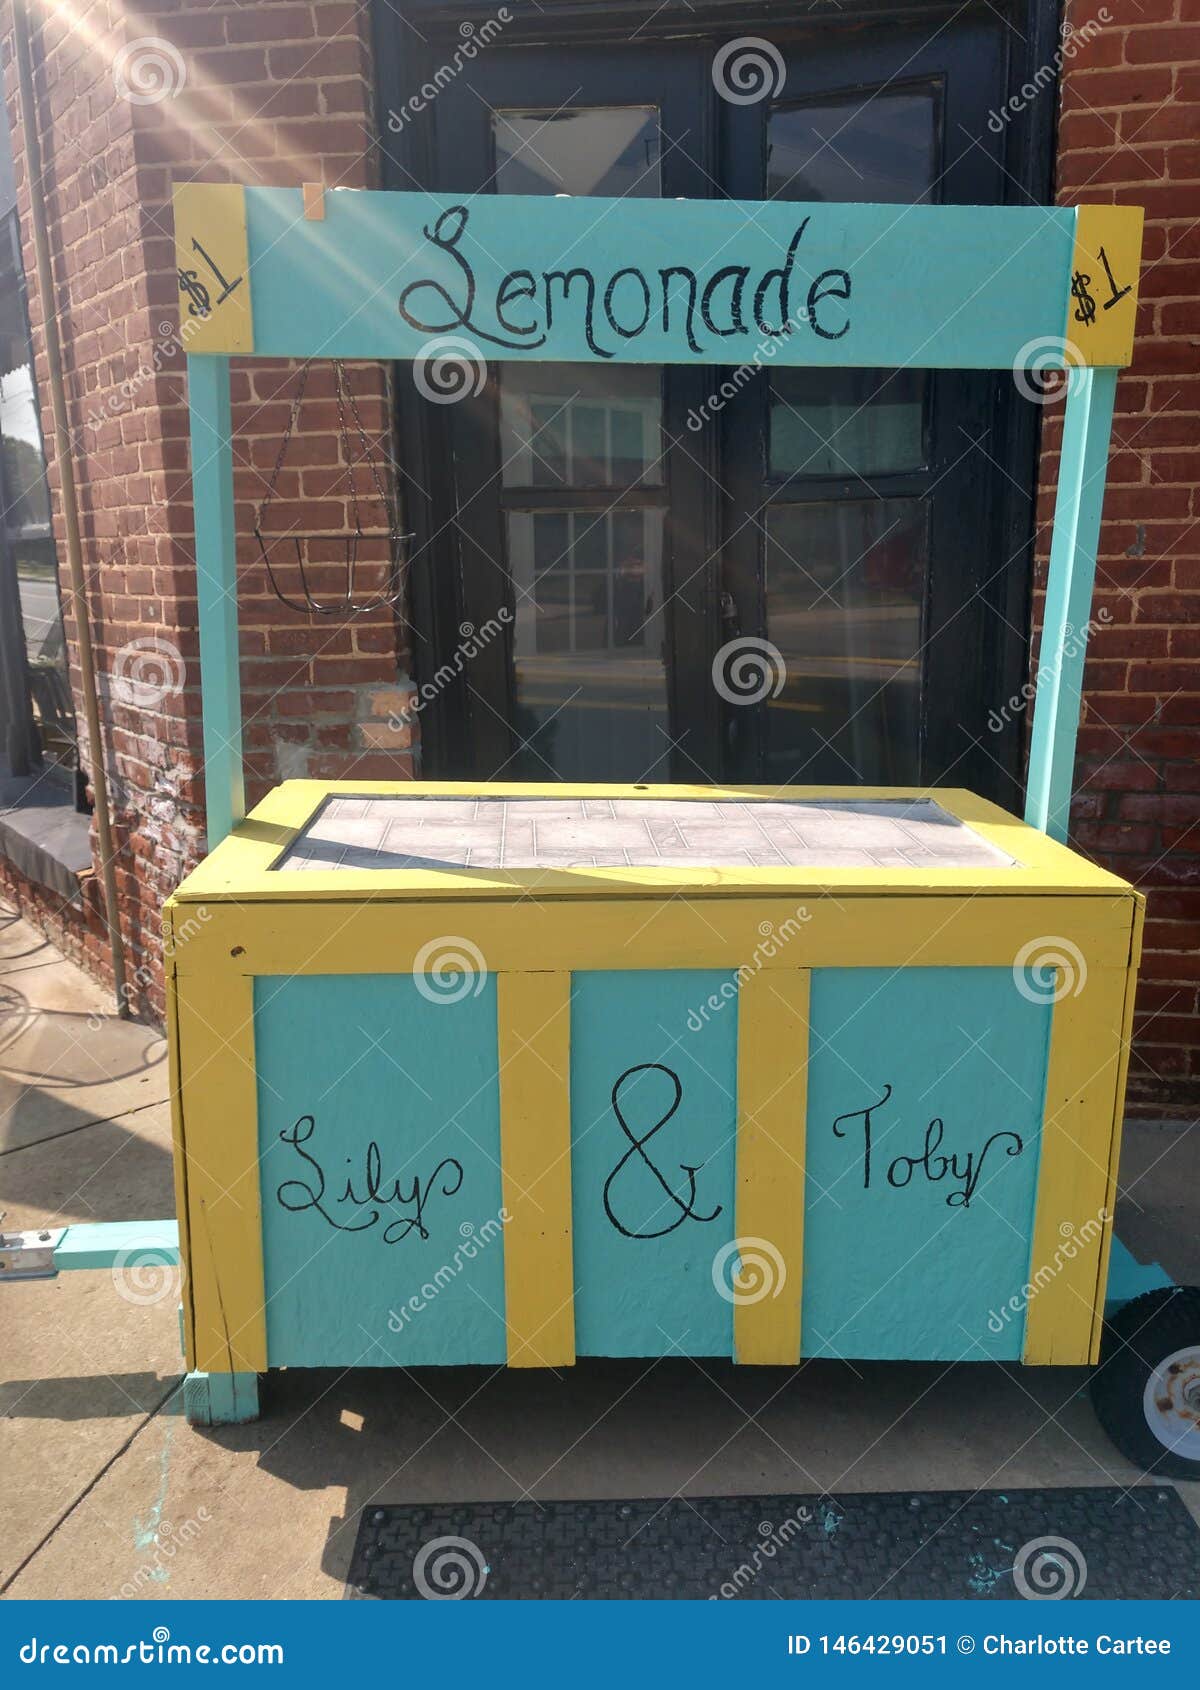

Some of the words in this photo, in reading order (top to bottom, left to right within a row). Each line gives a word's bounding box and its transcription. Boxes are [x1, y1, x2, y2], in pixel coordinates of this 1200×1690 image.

[177, 237, 243, 318] $1
[400, 205, 852, 355] Lemonade
[1071, 246, 1132, 327] $1
[277, 1115, 464, 1244] Lily
[603, 1063, 723, 1239] &
[833, 1084, 1023, 1208] Toby
